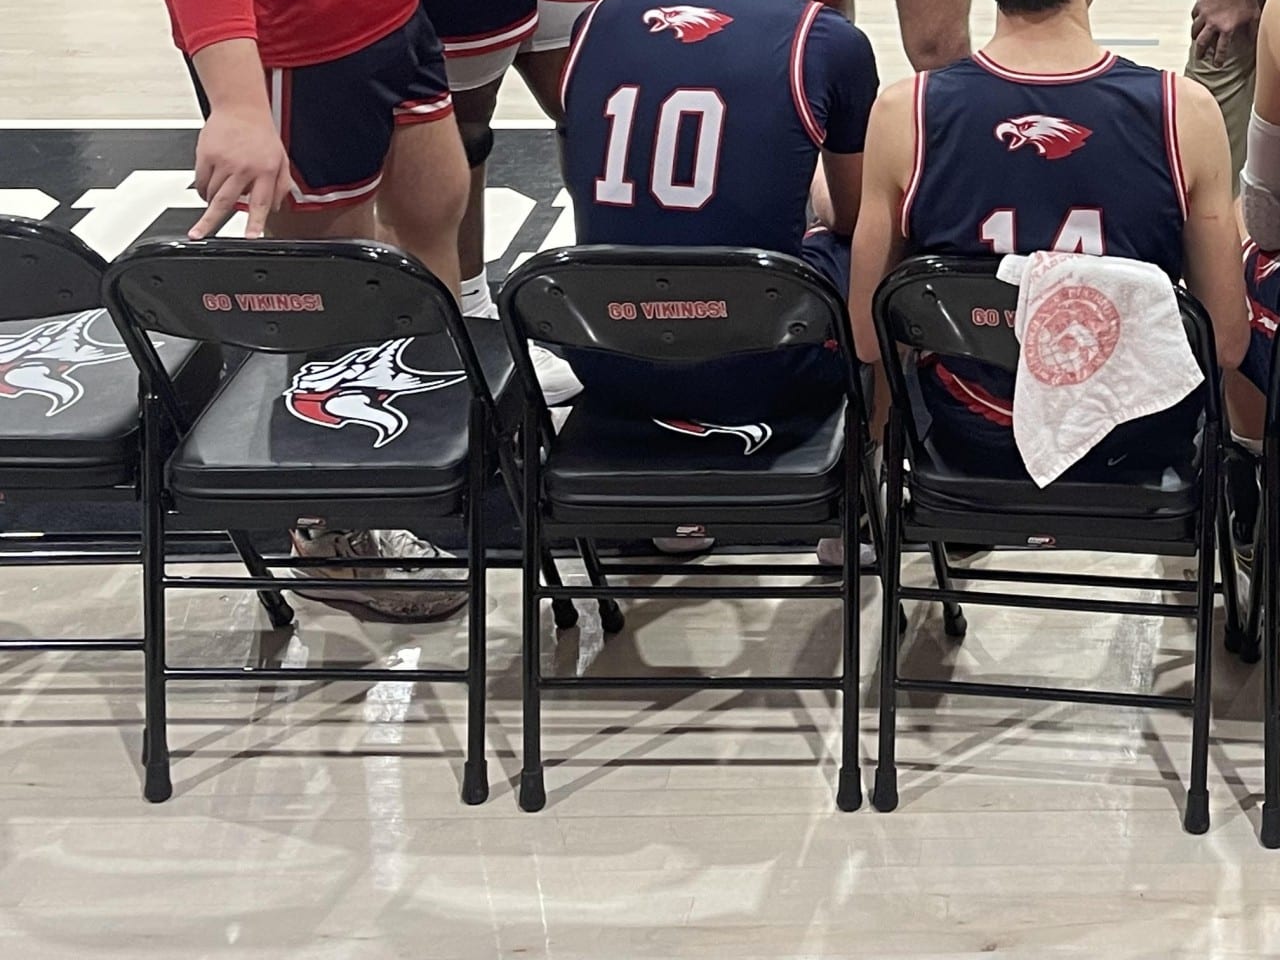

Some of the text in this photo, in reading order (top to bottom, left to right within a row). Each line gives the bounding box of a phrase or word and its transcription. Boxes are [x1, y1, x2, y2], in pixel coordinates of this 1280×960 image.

[594, 84, 727, 212] 10
[202, 293, 325, 312] GO VIKINGS!
[608, 300, 728, 320] GO VIKINGS!
[971, 308, 1000, 327] GO
